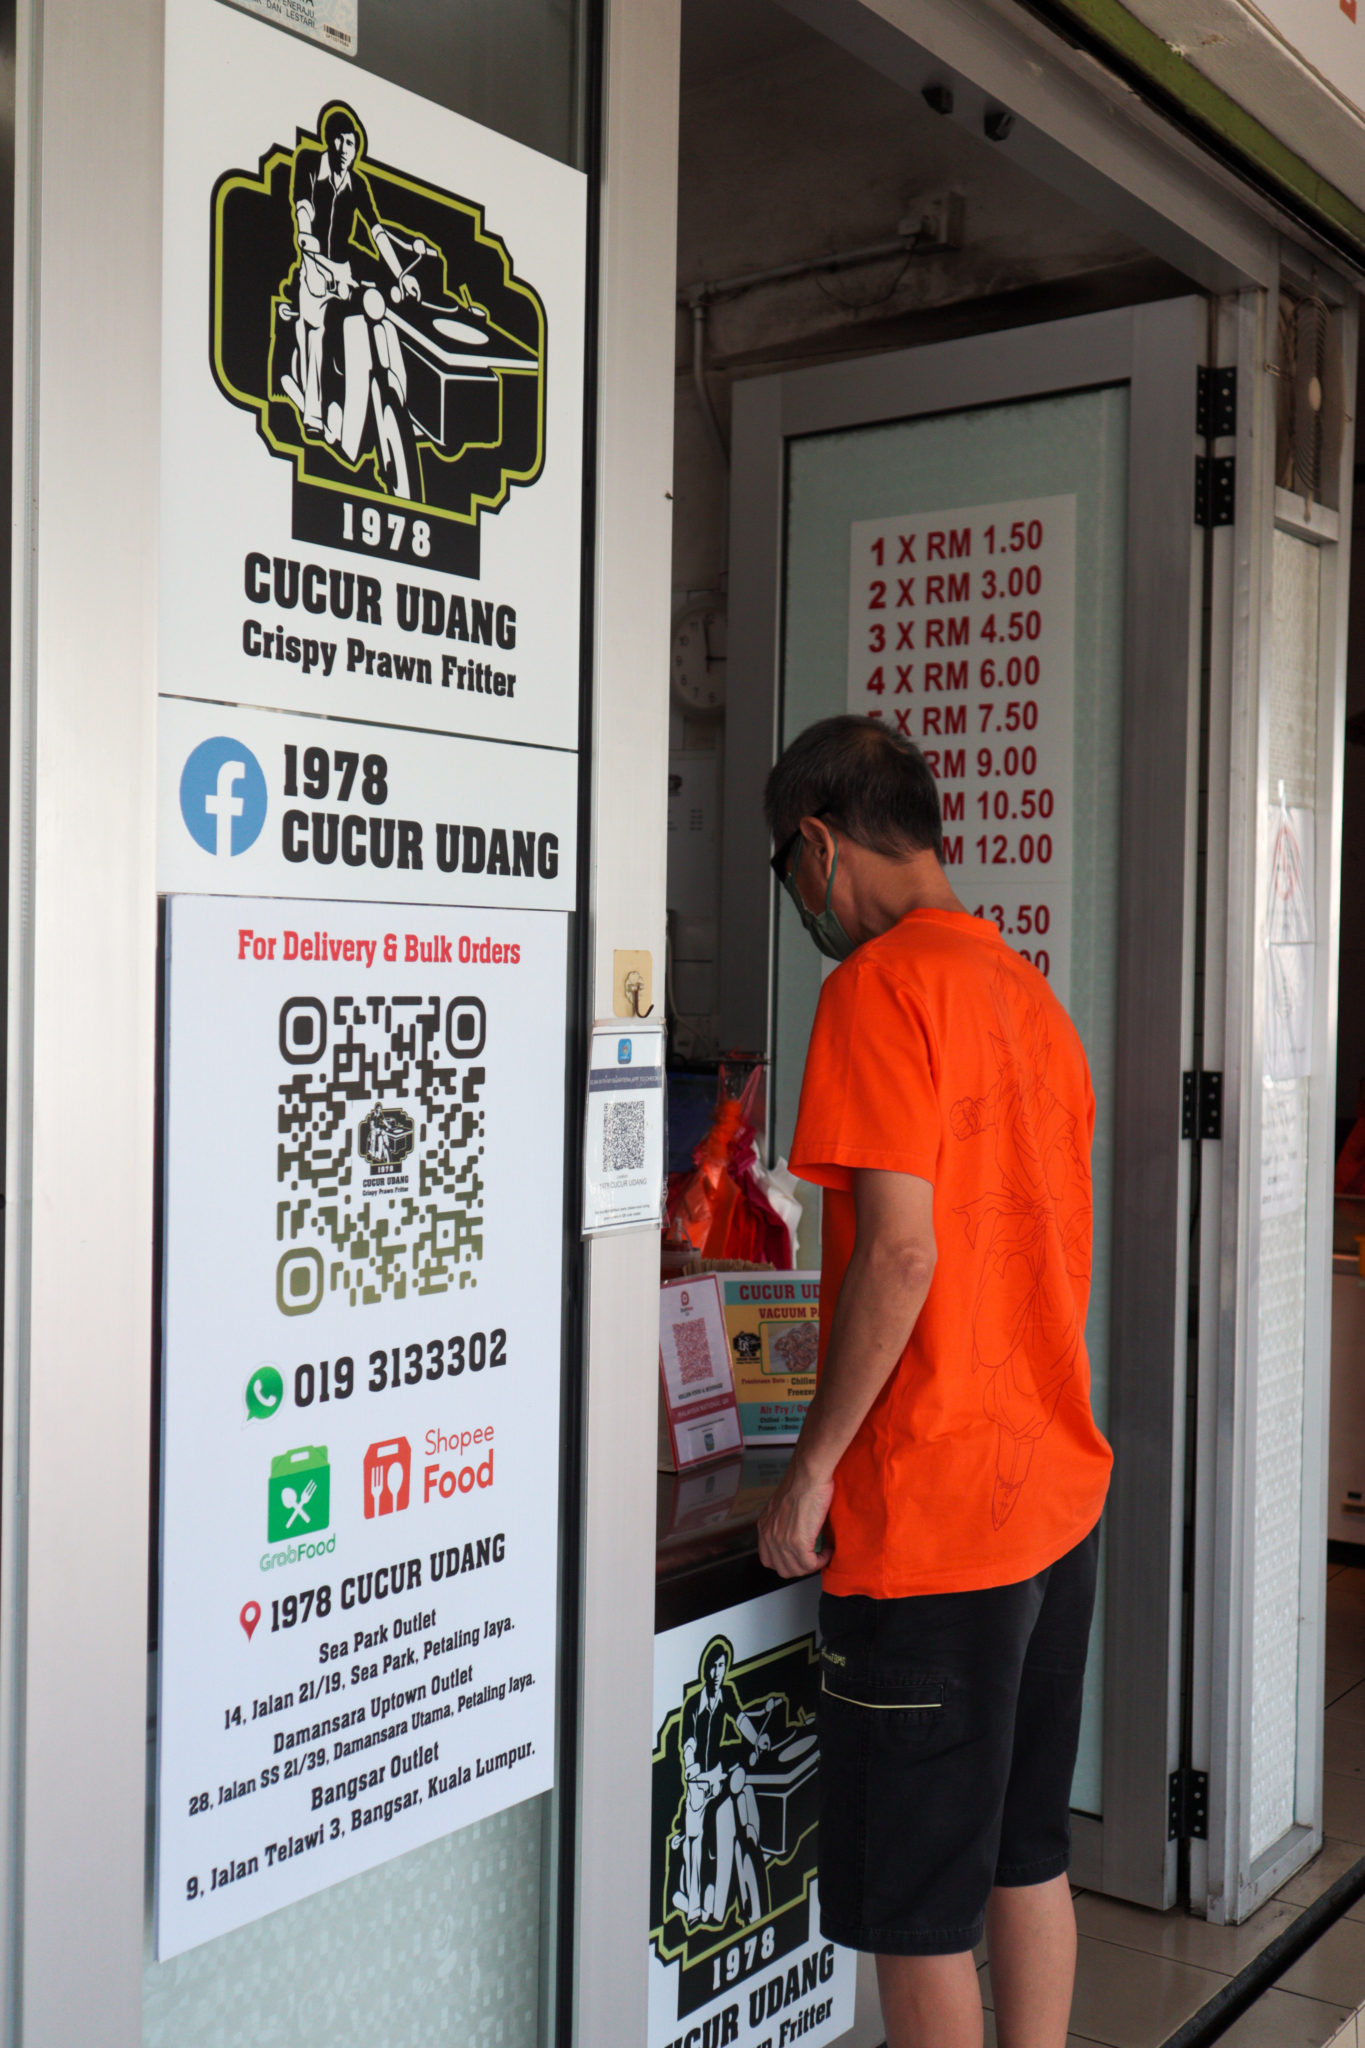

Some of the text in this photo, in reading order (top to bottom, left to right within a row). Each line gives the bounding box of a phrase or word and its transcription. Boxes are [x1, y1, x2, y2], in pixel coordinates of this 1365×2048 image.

[278, 0, 314, 18] ENERAJU
[286, 9, 315, 29] LESTARI
[343, 502, 431, 557] 1978
[870, 519, 1043, 566] 1 X RM 1.50
[244, 552, 517, 650] CUCUR UDANG
[868, 565, 1042, 610] 2 X RM 3.00
[868, 610, 1042, 653] 3 X RM 4.50
[242, 619, 517, 698] Crispy Prawn Fritter
[866, 655, 1040, 695] 4 X RM 6.00
[894, 700, 1038, 737] X RM 7.50
[284, 744, 388, 806] 1978
[923, 745, 1037, 779] RM 9.00
[943, 788, 1054, 821] M 10.50
[282, 809, 559, 880] CUCUR UDANG
[942, 834, 1053, 865] M 12.00
[237, 929, 521, 968] For Delivery & Bulk Orders
[362, 1175, 409, 1188] CUCUR UDANG
[739, 1284, 795, 1301] CUCUR
[758, 1307, 806, 1319] VACUUM
[294, 1328, 508, 1408] 019 3133302
[424, 1425, 495, 1457] Shopee
[424, 1449, 495, 1504] Food
[259, 1533, 336, 1573] GrabFood
[271, 1532, 506, 1633] 1978 CUCUR UDANG
[319, 1608, 437, 1665] Sea Park Outlet
[224, 1614, 516, 1730] 14, Jalan 21/19, Sea Park, Petaling Jaya.
[273, 1664, 473, 1755] Damansara Uptown Outlet
[188, 1671, 537, 1816] 28, Jalan SS 21/39, Damansara Utama, Petaling Jaya.
[310, 1741, 440, 1813] Bangsar Outlet
[186, 1739, 537, 1901] 9, Jalan Telawi 3, Bangsar, Kuala Lumpur.
[712, 1926, 775, 1991] 1978
[749, 1943, 835, 2029] UDANG
[778, 1996, 834, 2048] Fritter
